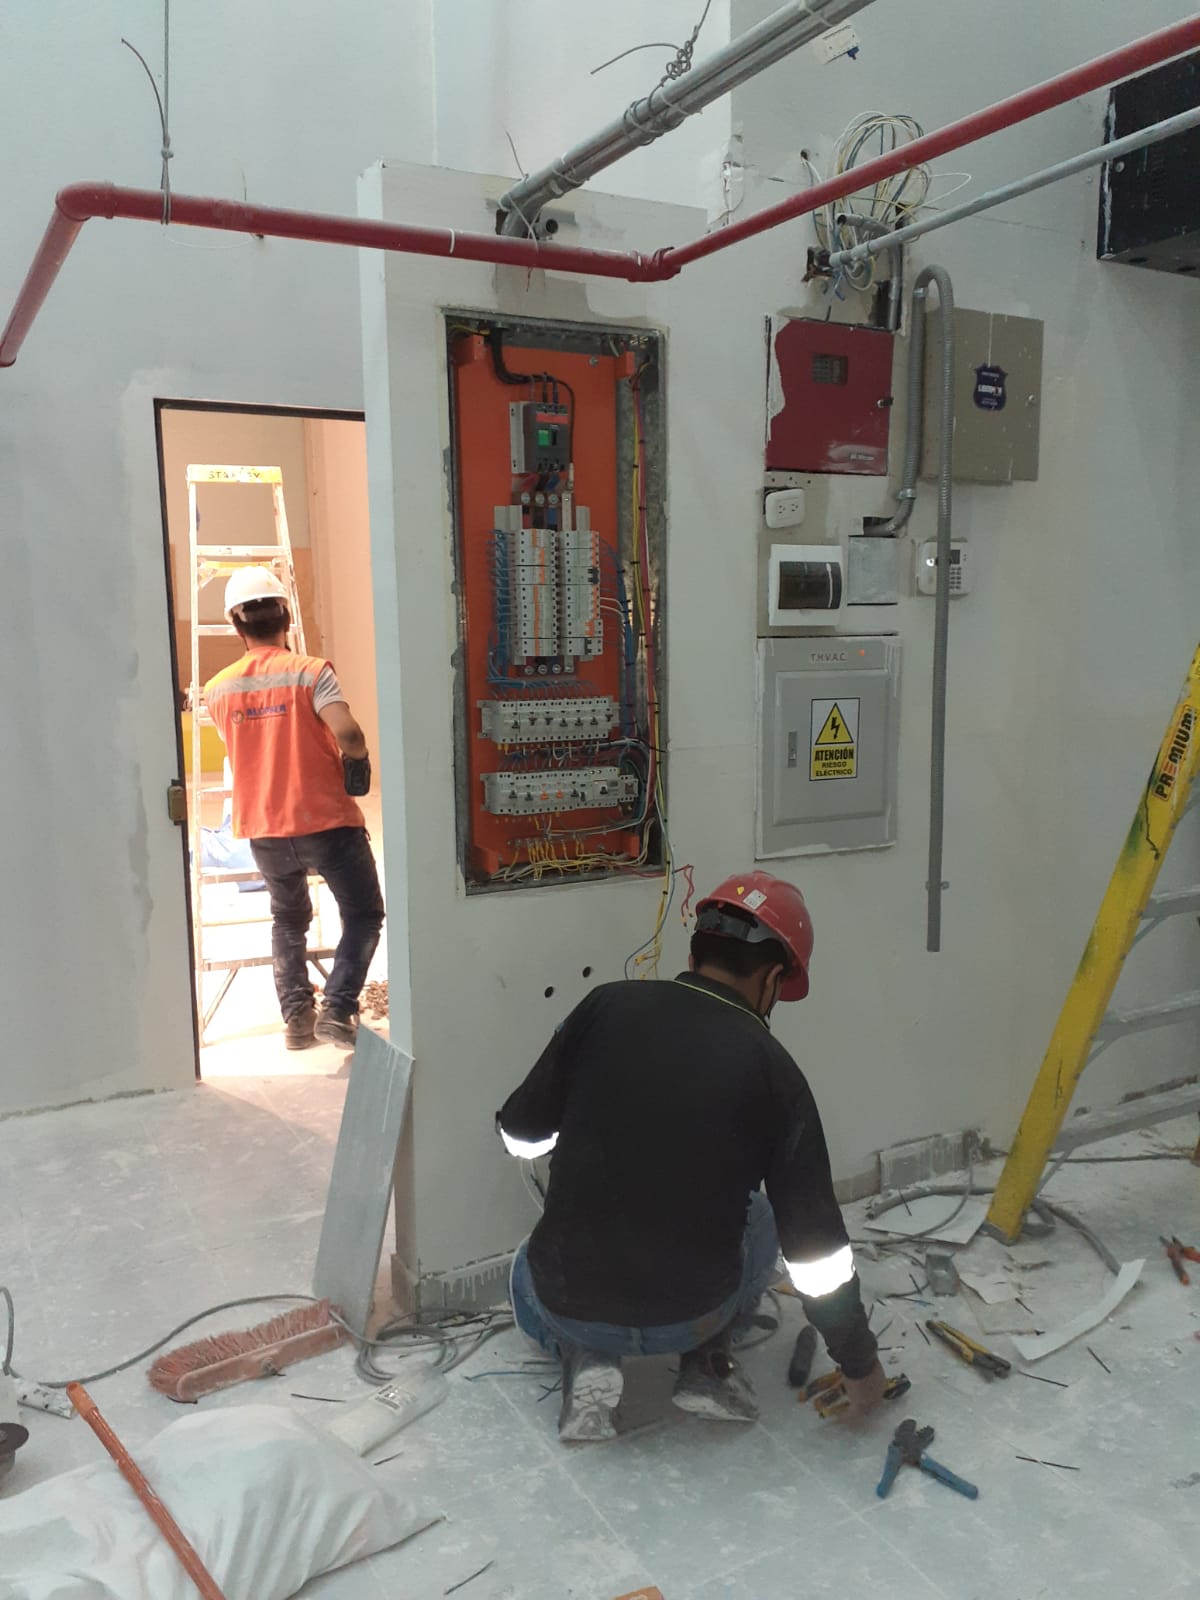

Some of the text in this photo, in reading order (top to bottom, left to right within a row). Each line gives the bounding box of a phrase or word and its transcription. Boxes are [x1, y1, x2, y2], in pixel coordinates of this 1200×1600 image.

[208, 471, 262, 480] STAEY
[814, 747, 854, 761] ATENCIÓN
[821, 761, 847, 769] RIESGO
